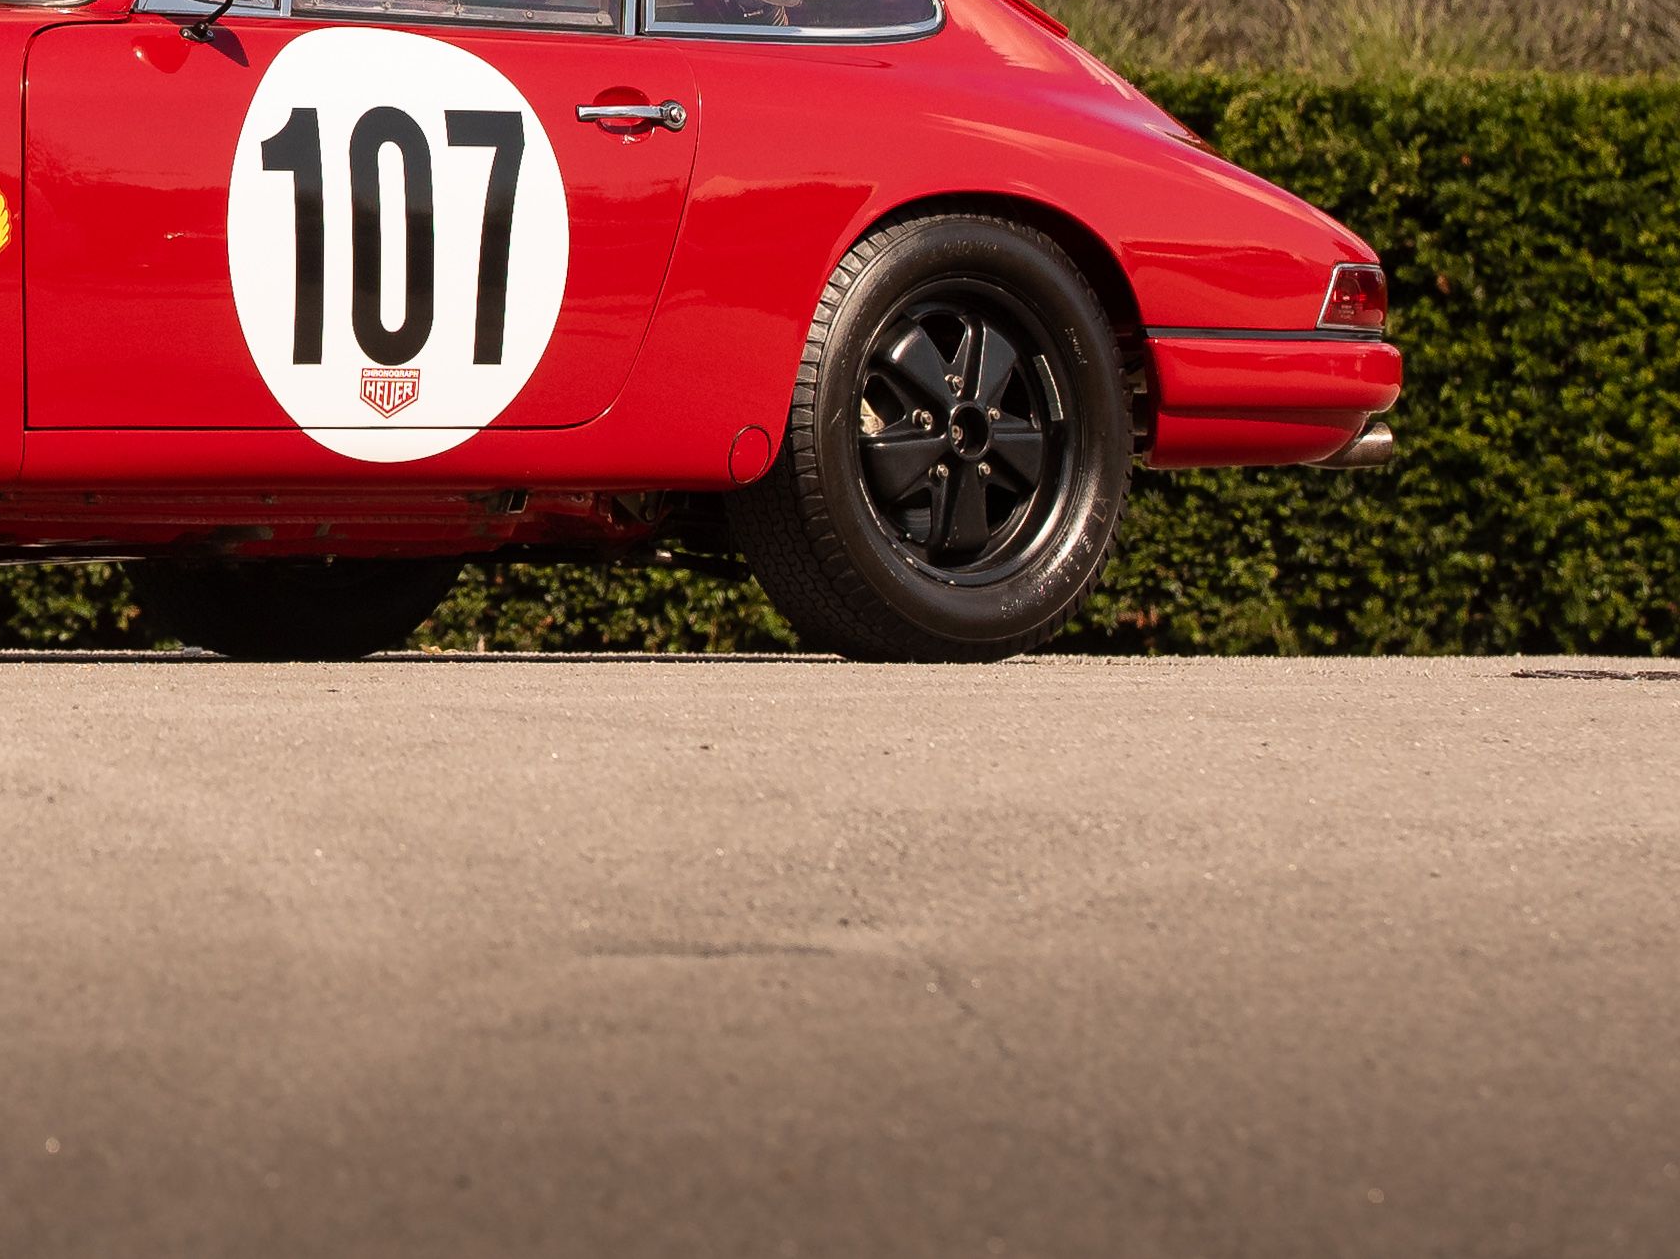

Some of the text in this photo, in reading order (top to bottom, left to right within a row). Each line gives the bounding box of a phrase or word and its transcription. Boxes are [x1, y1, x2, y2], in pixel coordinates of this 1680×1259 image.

[261, 106, 526, 366] 107
[363, 369, 419, 378] CHRONOGRAPH
[365, 382, 414, 410] HEUER
